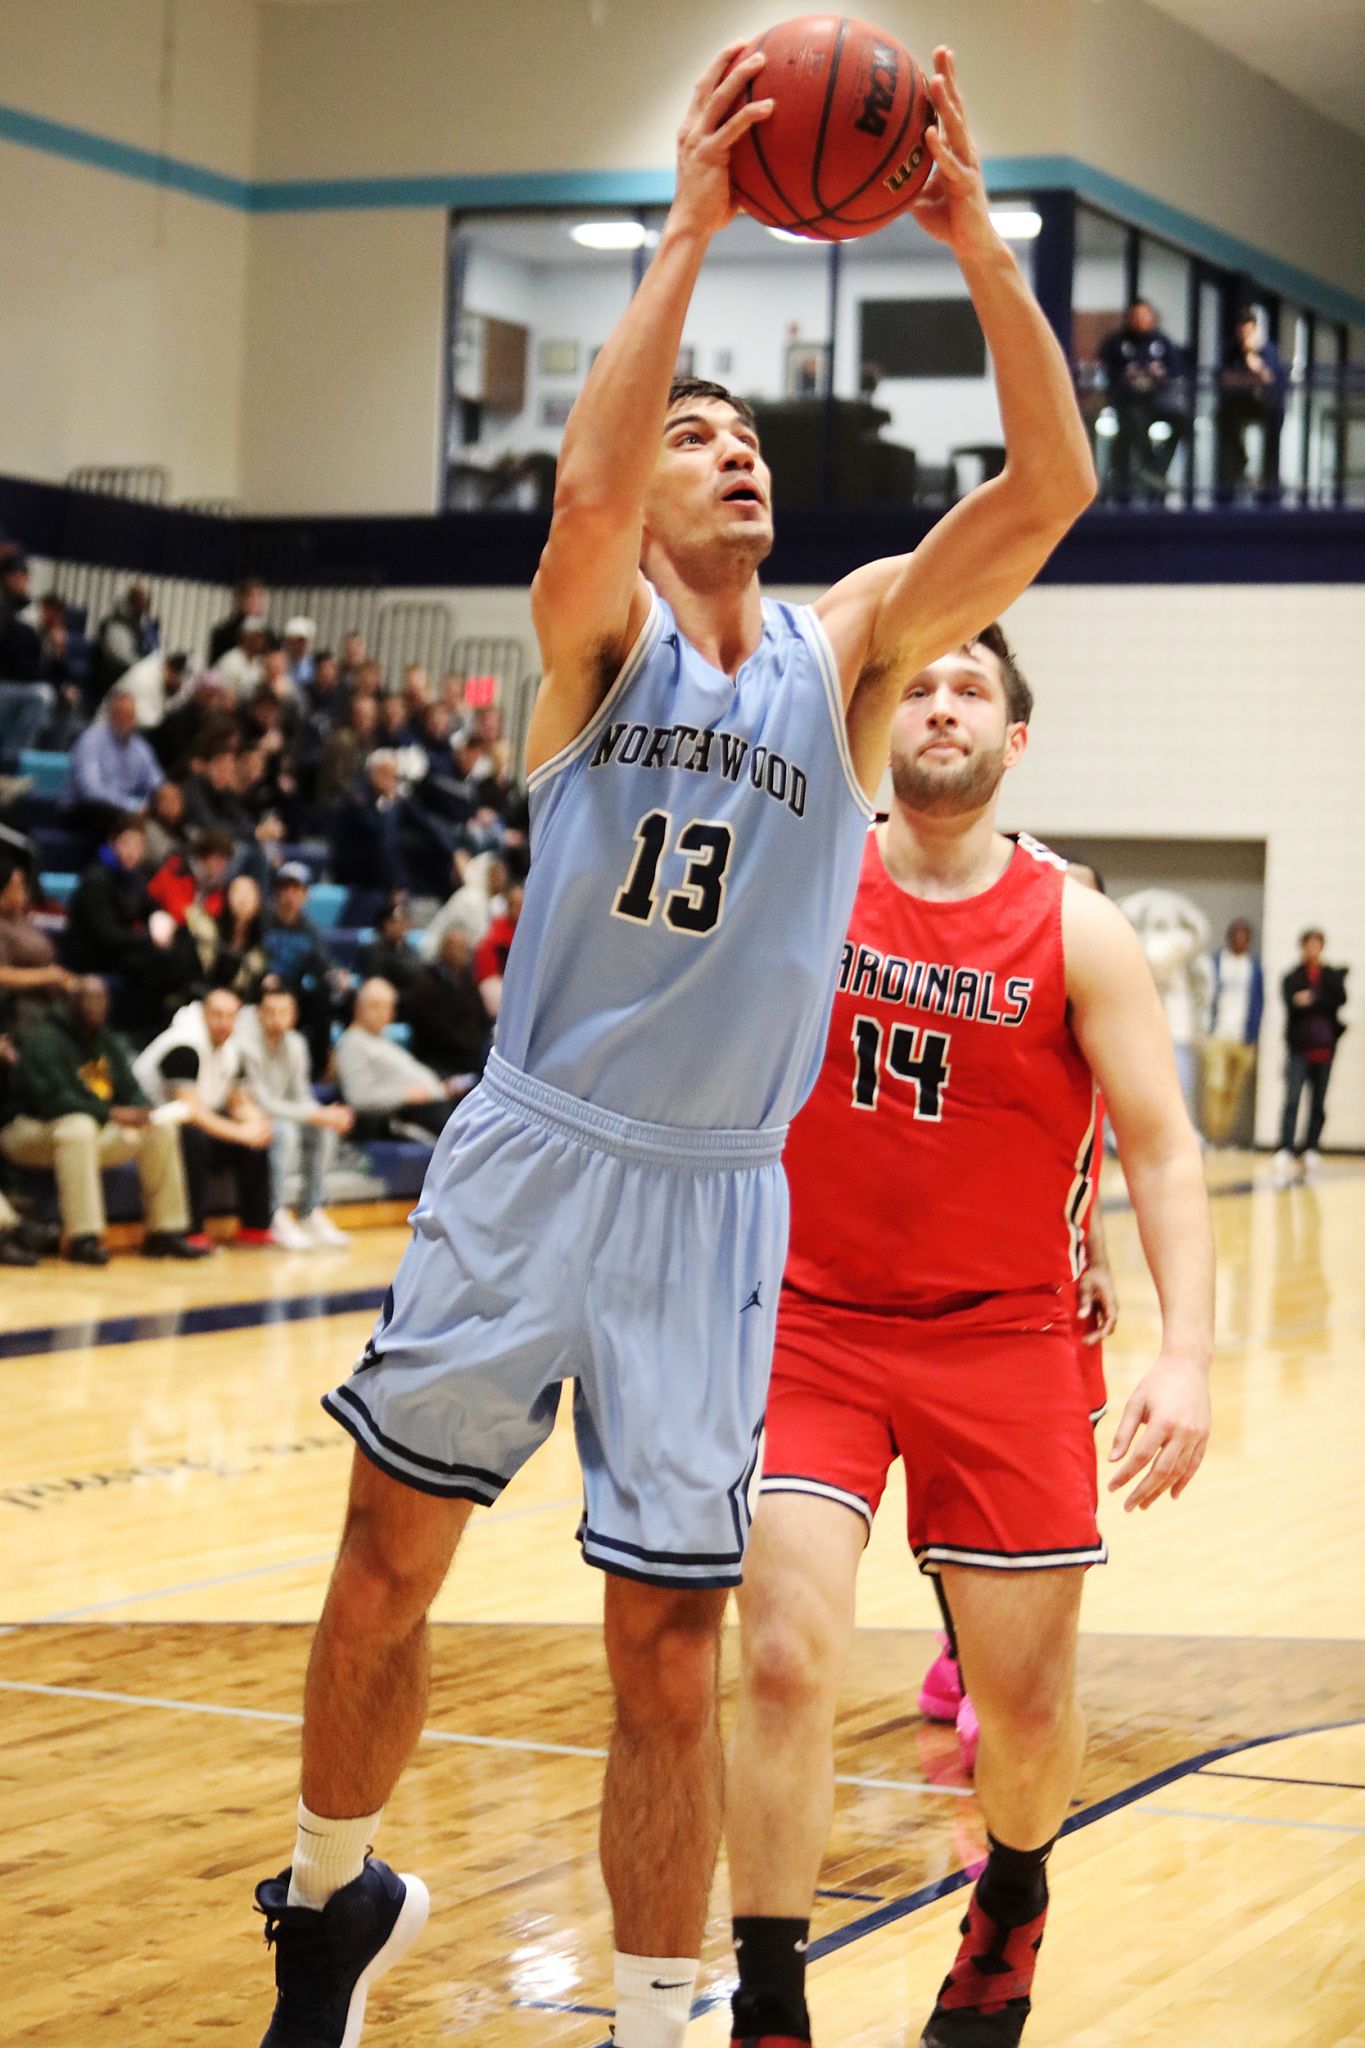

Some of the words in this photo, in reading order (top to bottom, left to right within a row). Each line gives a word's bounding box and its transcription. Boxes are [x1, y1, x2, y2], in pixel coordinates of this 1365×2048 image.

[589, 722, 808, 819] NORTHWOOD
[610, 808, 735, 938] 13
[835, 940, 1034, 1027] ARDINALS
[850, 1013, 951, 1122] 14
